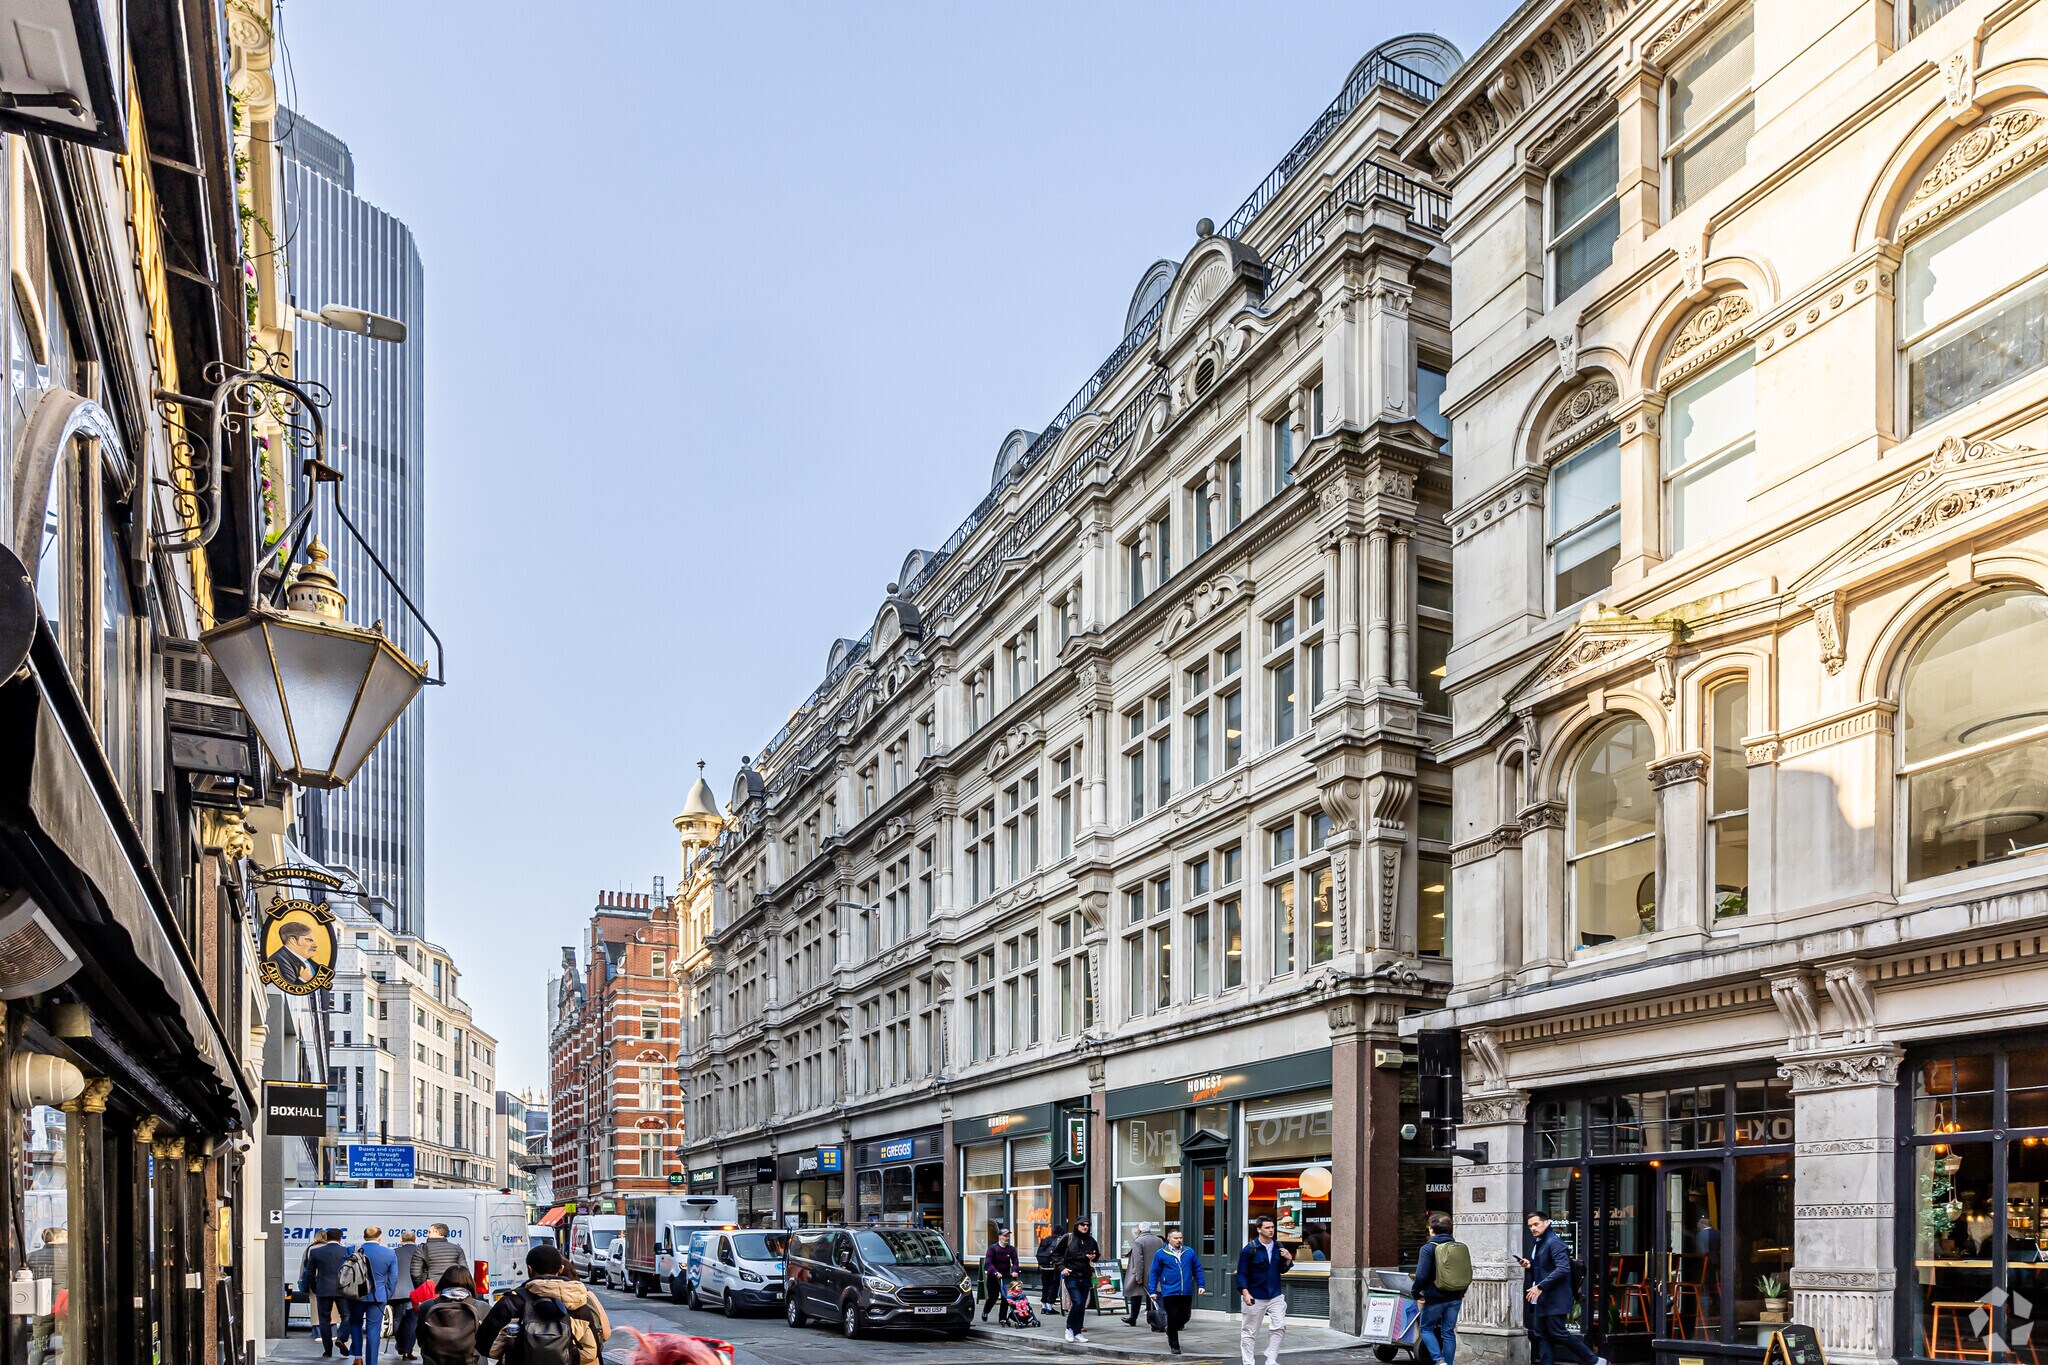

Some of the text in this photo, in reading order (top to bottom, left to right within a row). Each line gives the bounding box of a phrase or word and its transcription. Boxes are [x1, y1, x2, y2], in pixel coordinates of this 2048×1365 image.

[266, 869, 340, 887] NICHOLSON'S
[286, 902, 318, 913] LORD
[268, 965, 328, 993] ABERCONWAY
[1187, 1075, 1222, 1093] HONEST
[270, 1105, 323, 1118] BOXHALL
[988, 1115, 1010, 1127] HONEST
[1076, 1126, 1084, 1155] HONEST
[886, 1143, 910, 1157] GREGGS
